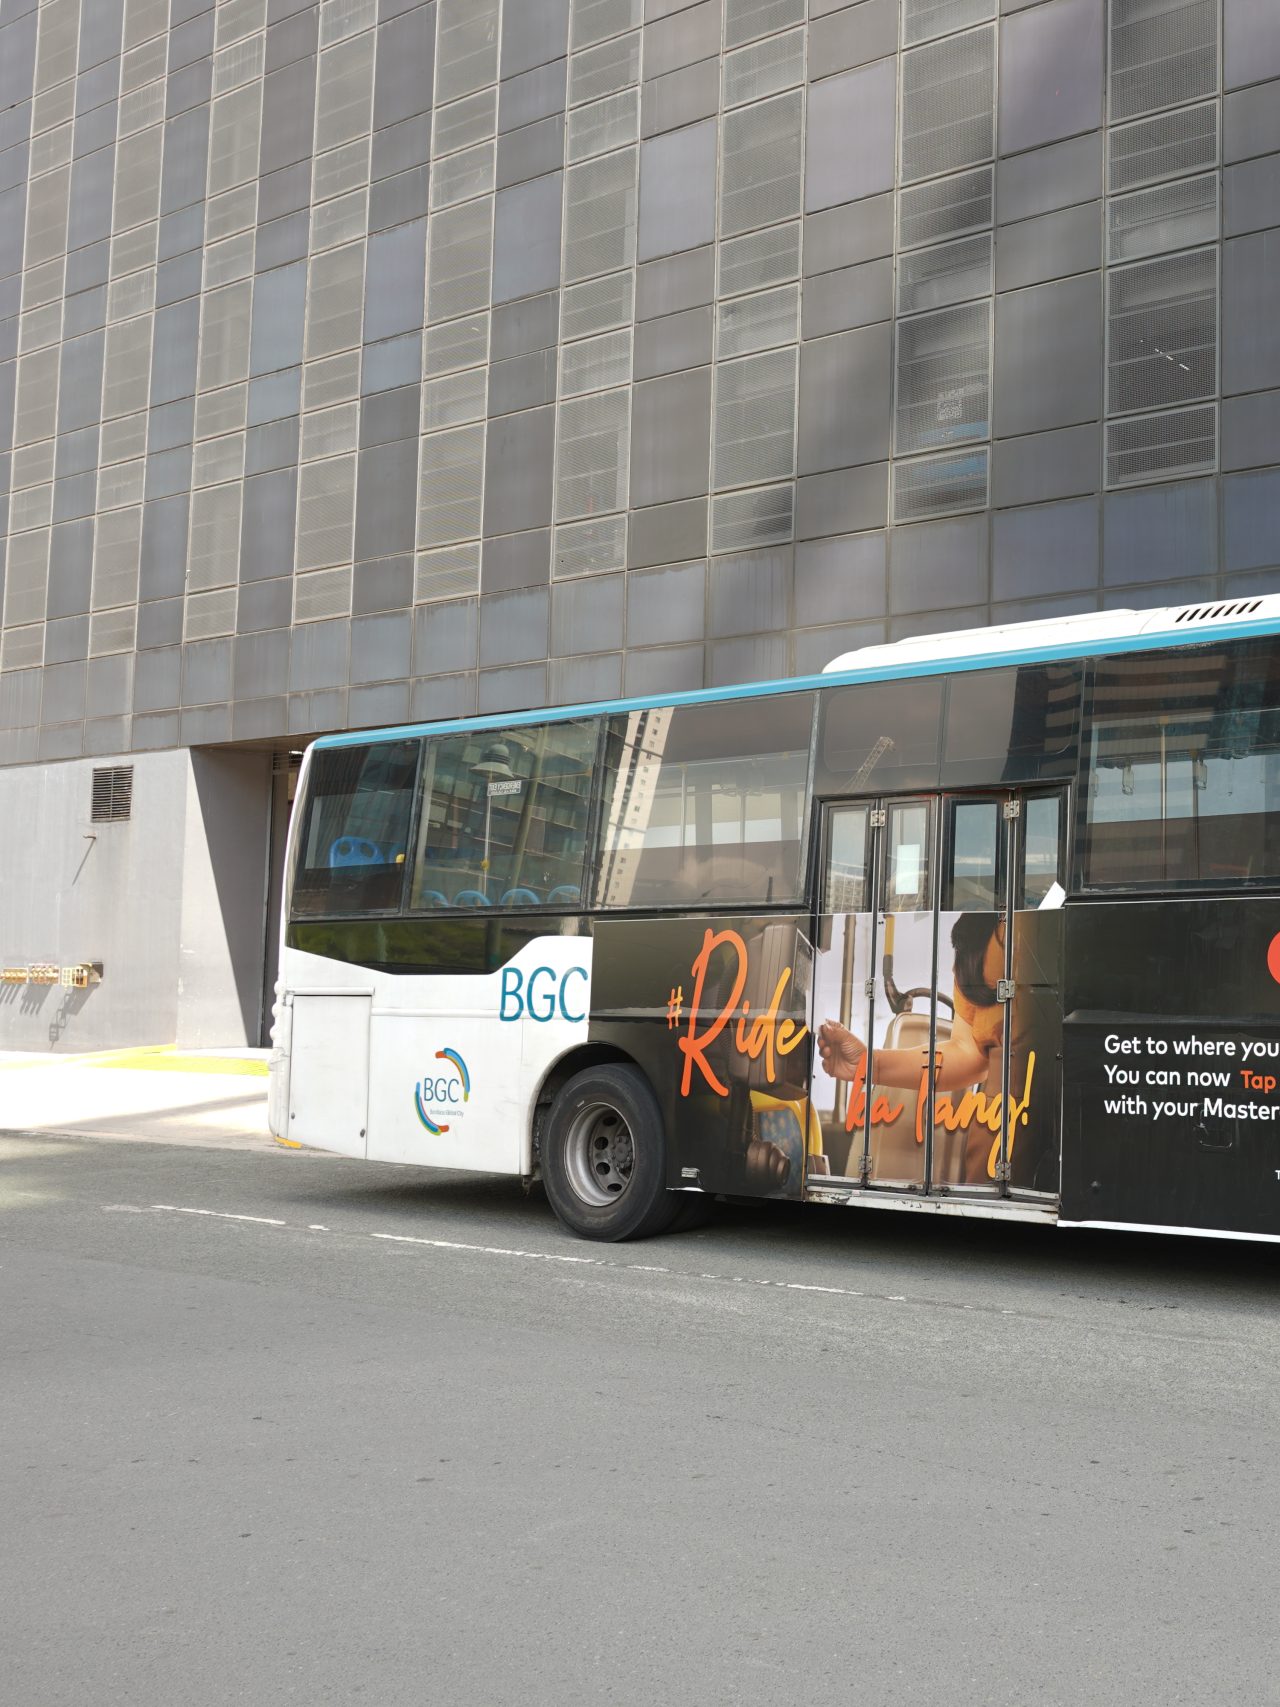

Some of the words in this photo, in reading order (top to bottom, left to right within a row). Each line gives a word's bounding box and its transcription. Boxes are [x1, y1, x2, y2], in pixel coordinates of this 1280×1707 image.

[499, 966, 588, 1022] BGC
[1104, 1034, 1141, 1054] Get
[1146, 1036, 1168, 1055] to
[1173, 1035, 1236, 1056] where
[1241, 1041, 1280, 1062] you
[423, 1077, 460, 1103] BGC
[1104, 1064, 1140, 1085] You
[1145, 1070, 1181, 1086] can
[1187, 1072, 1231, 1087] now
[1240, 1069, 1276, 1094] Tap
[1104, 1095, 1147, 1115] with
[1152, 1101, 1199, 1120] your
